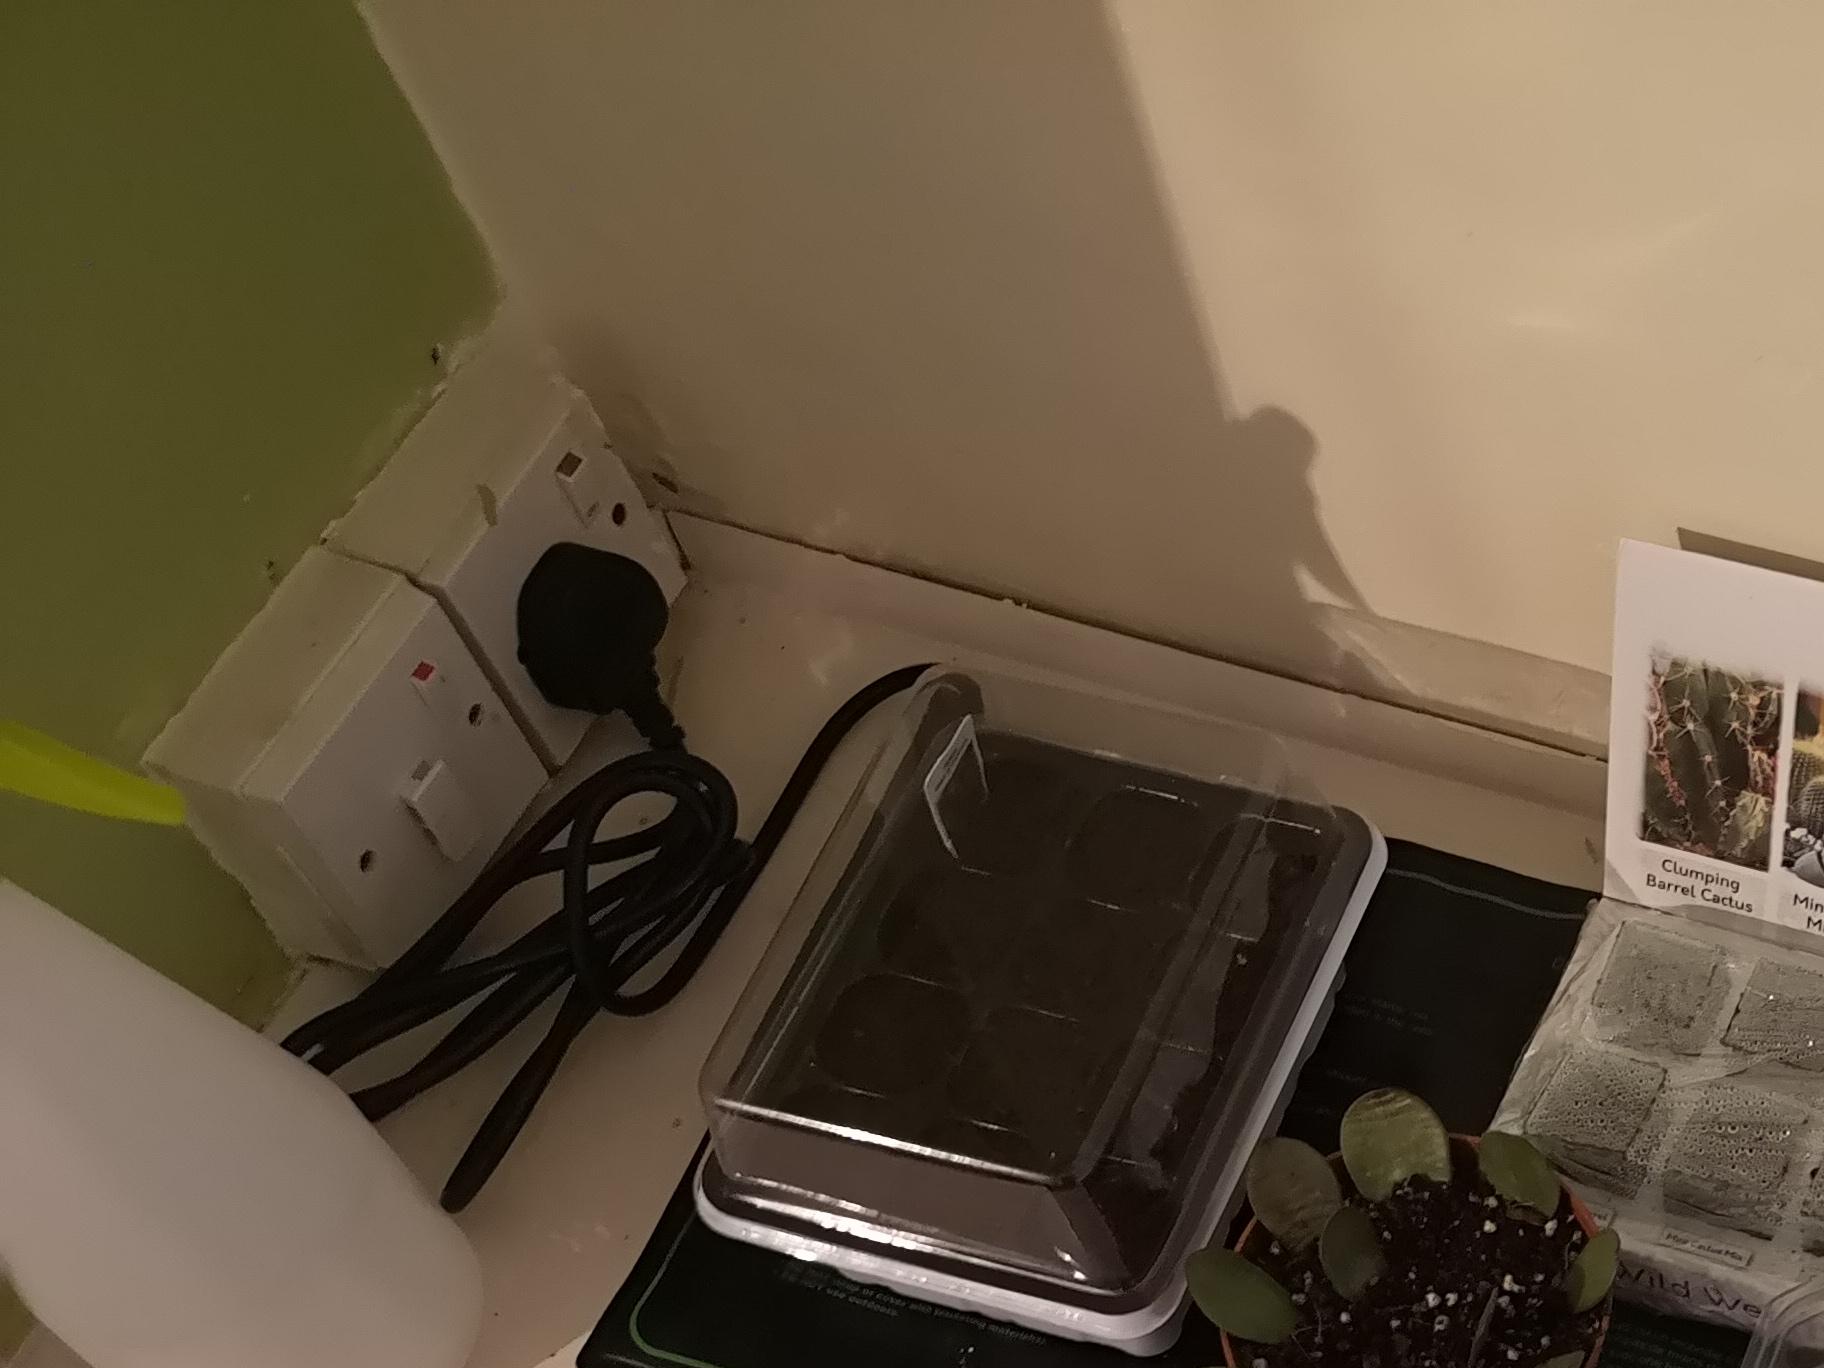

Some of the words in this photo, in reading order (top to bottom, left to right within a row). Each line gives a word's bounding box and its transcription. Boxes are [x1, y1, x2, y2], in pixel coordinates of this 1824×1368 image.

[1646, 873, 1695, 899] Barrel
[1700, 888, 1754, 913] Cactus
[1661, 858, 1741, 894] Clumping
[1615, 1260, 1690, 1300] Wild
[1702, 1285, 1762, 1320] We
